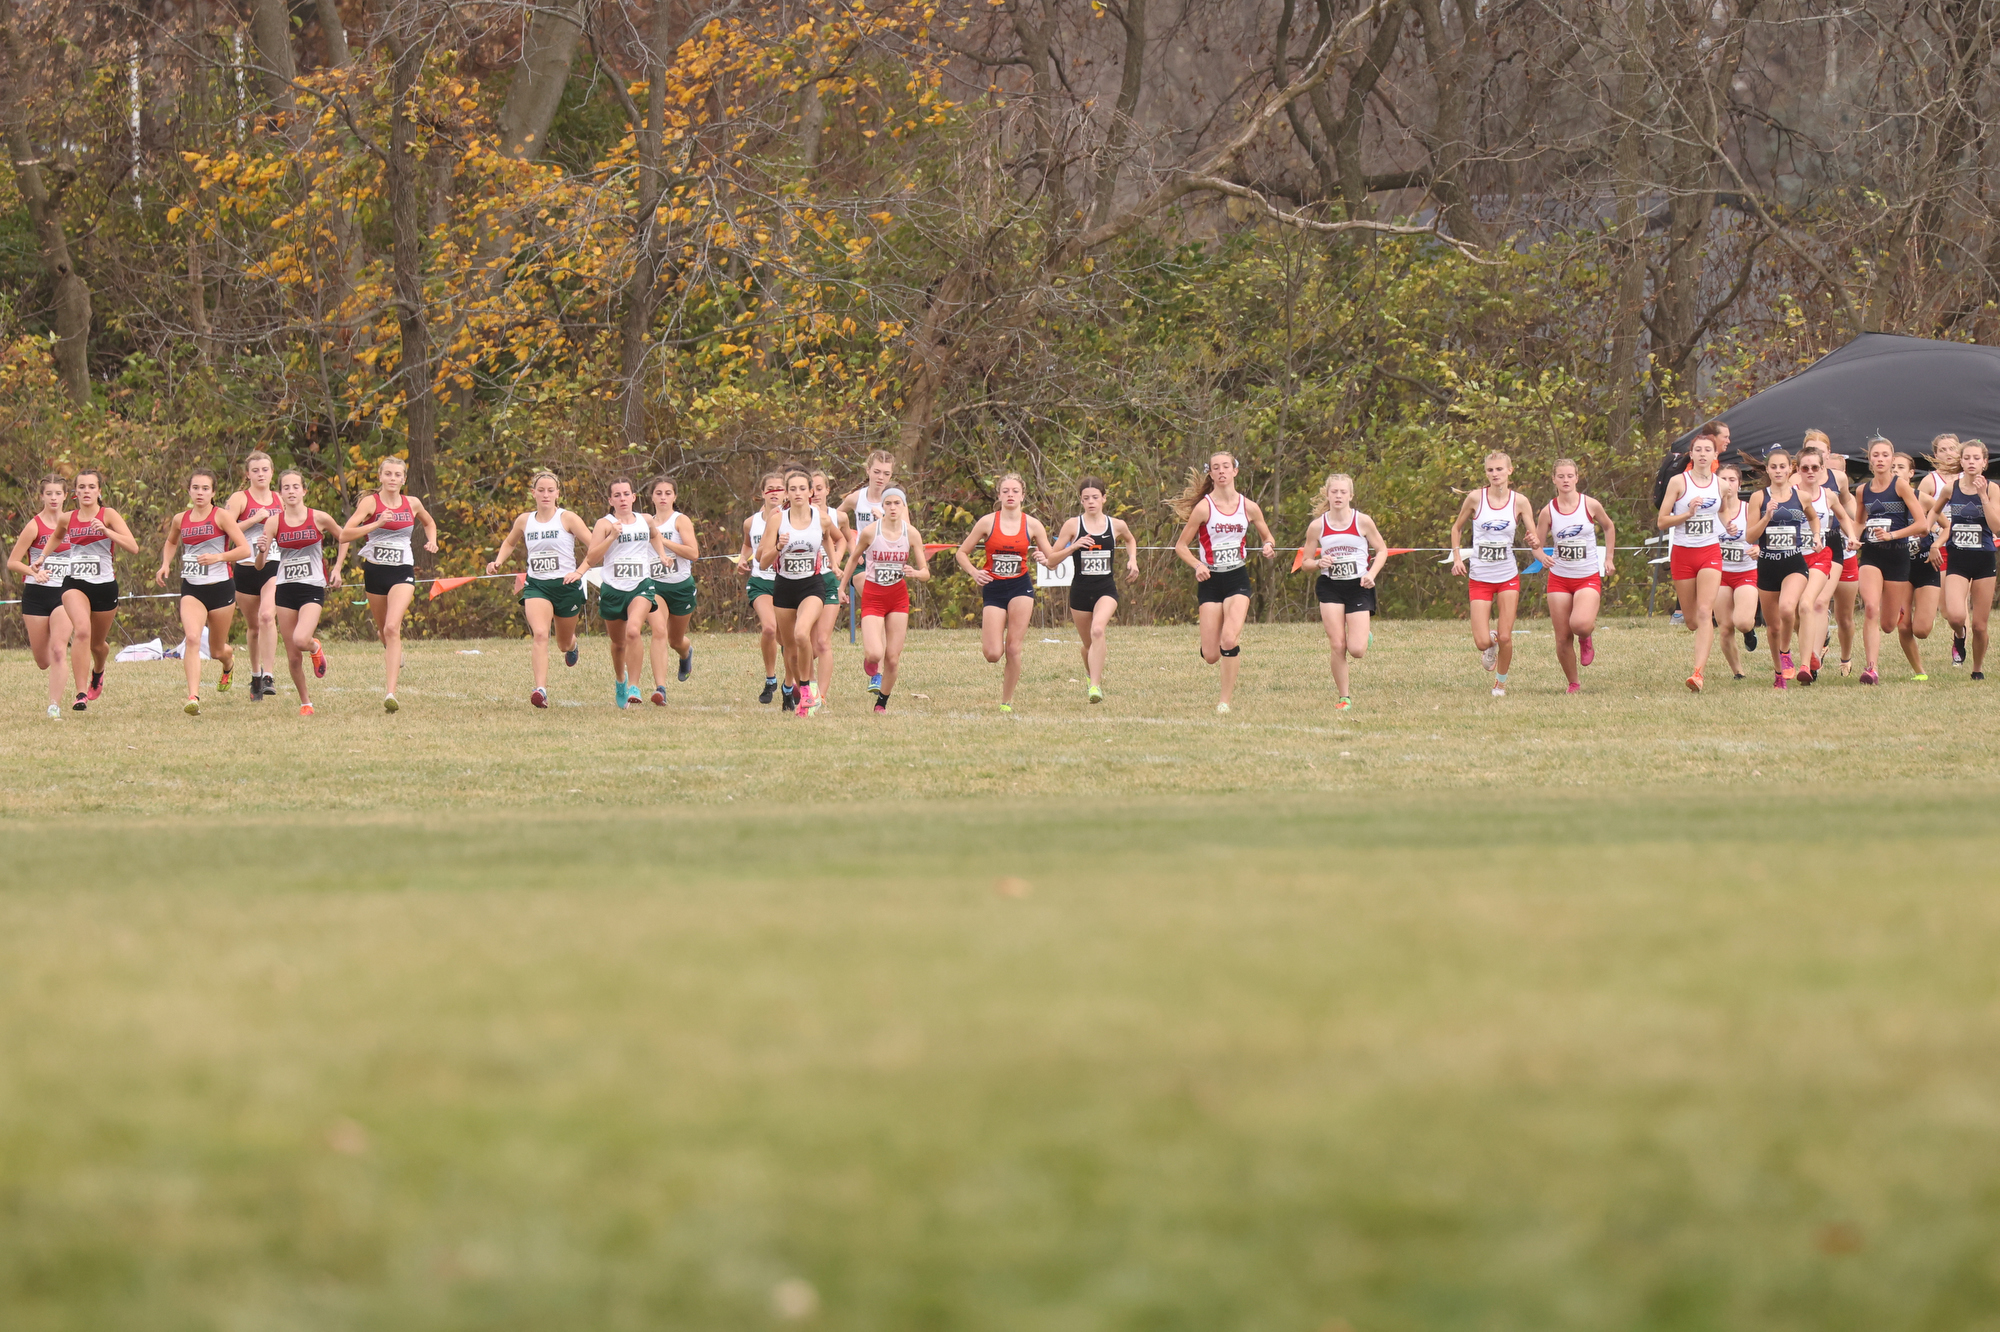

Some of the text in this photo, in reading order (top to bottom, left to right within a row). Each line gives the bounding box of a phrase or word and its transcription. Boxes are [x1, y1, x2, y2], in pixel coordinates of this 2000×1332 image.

[858, 512, 870, 521] THE
[1688, 521, 1711, 534] 2213
[278, 529, 317, 543] ALDER
[527, 530, 559, 541] THE LEAF
[617, 532, 631, 544] THE
[1769, 534, 1793, 546] 2225
[1955, 532, 1979, 545] 2226
[376, 548, 401, 562] 2233
[872, 550, 909, 562] HAWKEN
[1215, 548, 1239, 563] 2332
[1324, 545, 1358, 556] NORTHWEST
[1481, 547, 1505, 560] 2214
[1560, 546, 1584, 559] 2219
[1720, 548, 1741, 561] 218
[1765, 552, 1781, 560] PRO
[47, 564, 68, 578] 2230
[73, 563, 98, 576] 2228
[183, 562, 206, 575] 2231
[286, 563, 310, 579] 2229
[533, 558, 557, 571] 2206
[617, 564, 640, 577] 2211
[787, 559, 812, 572] 2335
[995, 561, 1019, 573] 2337
[1045, 561, 1067, 580] 10
[1084, 559, 1108, 571] 2331
[1331, 562, 1355, 576] 2330
